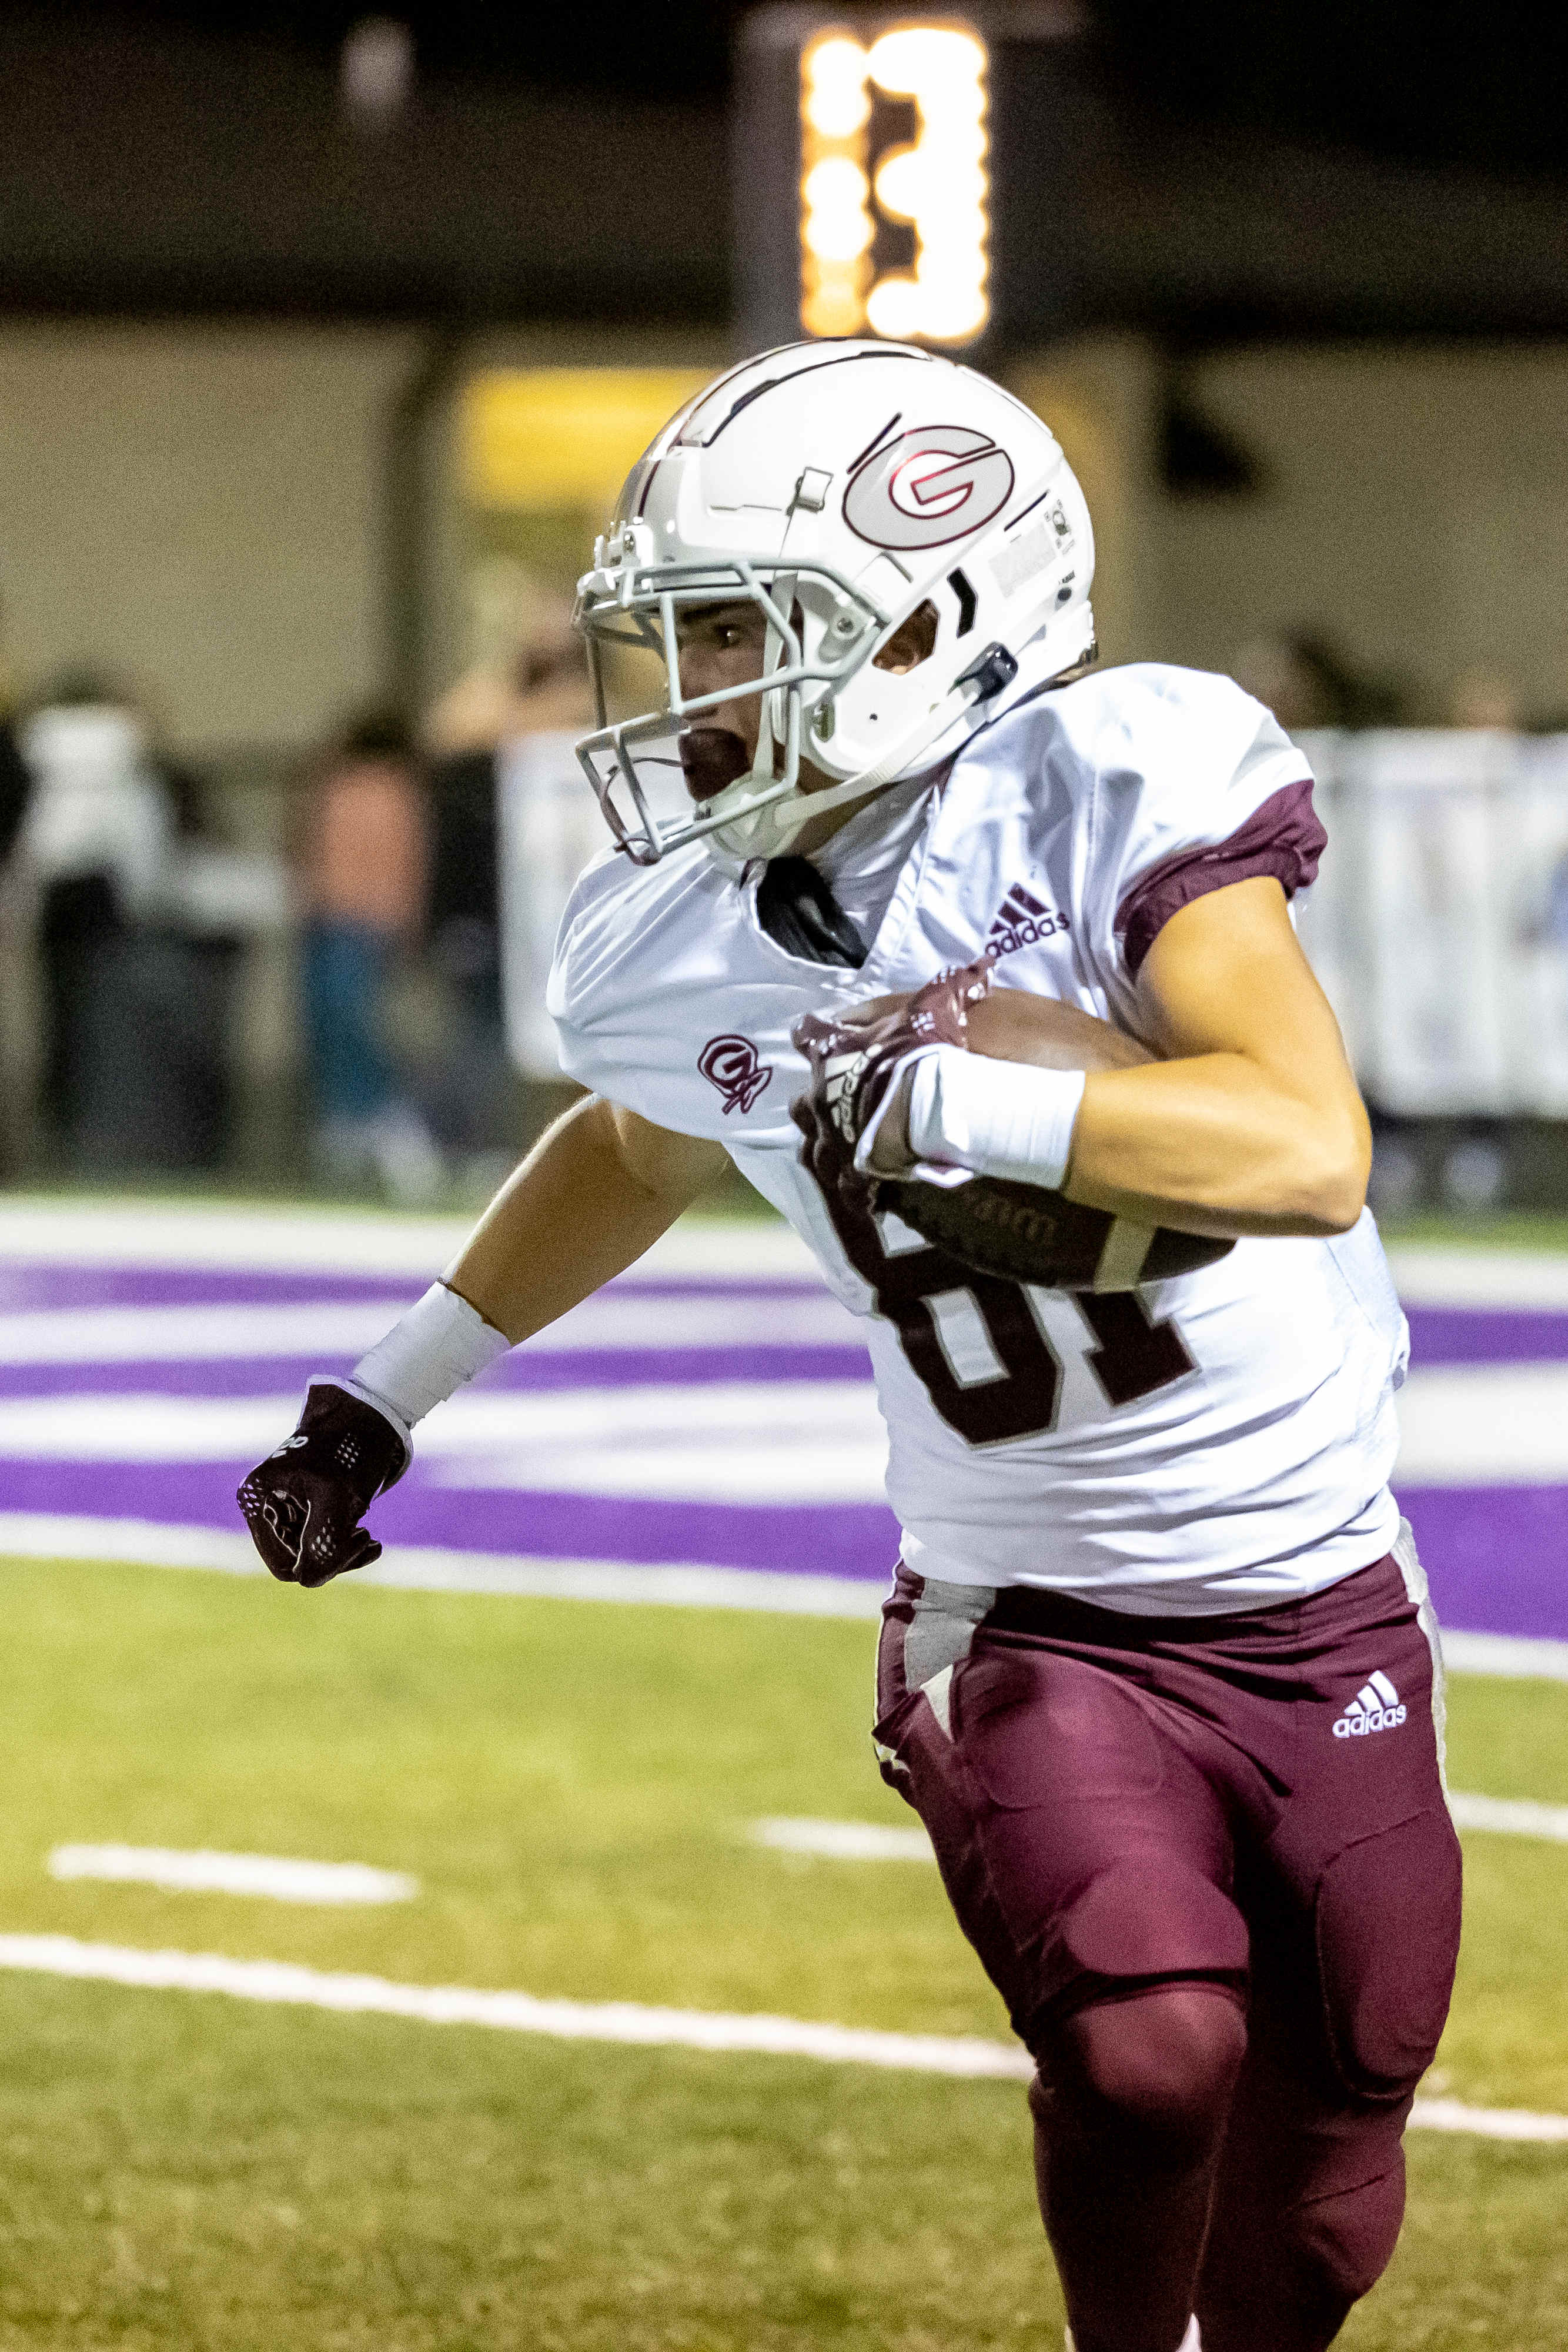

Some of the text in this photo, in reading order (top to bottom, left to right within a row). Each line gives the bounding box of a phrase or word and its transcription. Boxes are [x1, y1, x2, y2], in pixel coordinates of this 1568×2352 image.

[842, 425, 1015, 551] G
[984, 911, 1070, 958] adidas
[1332, 1704, 1407, 1739] adidas
